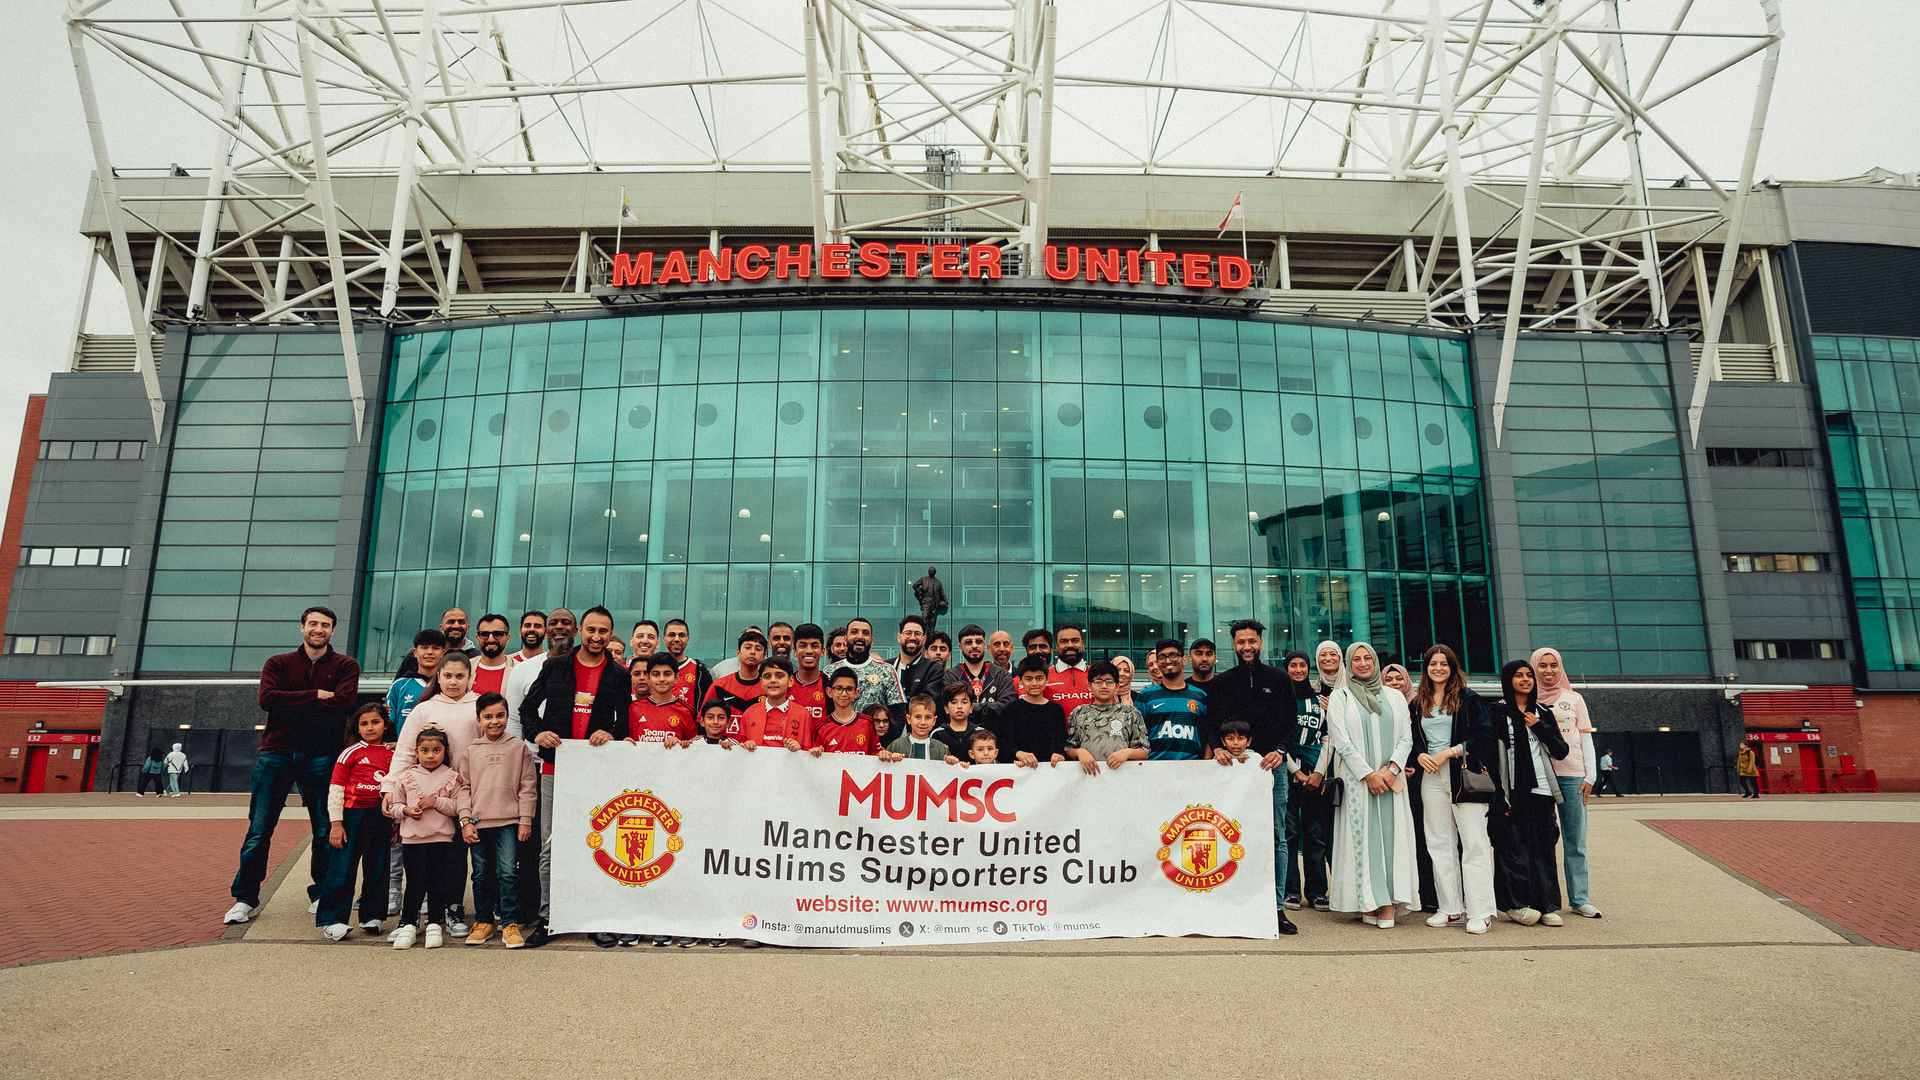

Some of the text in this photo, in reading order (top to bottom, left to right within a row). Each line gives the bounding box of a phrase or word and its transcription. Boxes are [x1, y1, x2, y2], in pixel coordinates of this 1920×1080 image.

[612, 242, 1252, 290] MANCHESTER UNITED
[643, 728, 666, 737] Team
[1158, 720, 1194, 740] AON
[356, 782, 380, 792] Snapd
[838, 769, 1017, 823] MUMSC
[596, 796, 674, 828] MANCHESTER
[1166, 810, 1235, 841] MANCHESTER
[763, 820, 1081, 857] Manchester United
[608, 863, 661, 881] UNITED
[703, 848, 1138, 892] Muslims Supporters Club
[1175, 872, 1225, 887] UNITED
[796, 895, 1048, 916] website: www.mumsc.org
[761, 920, 791, 932] Insta:
[794, 923, 892, 935] @manutdmuslims
[919, 924, 930, 934] X:
[1011, 922, 1050, 933] TikTok:
